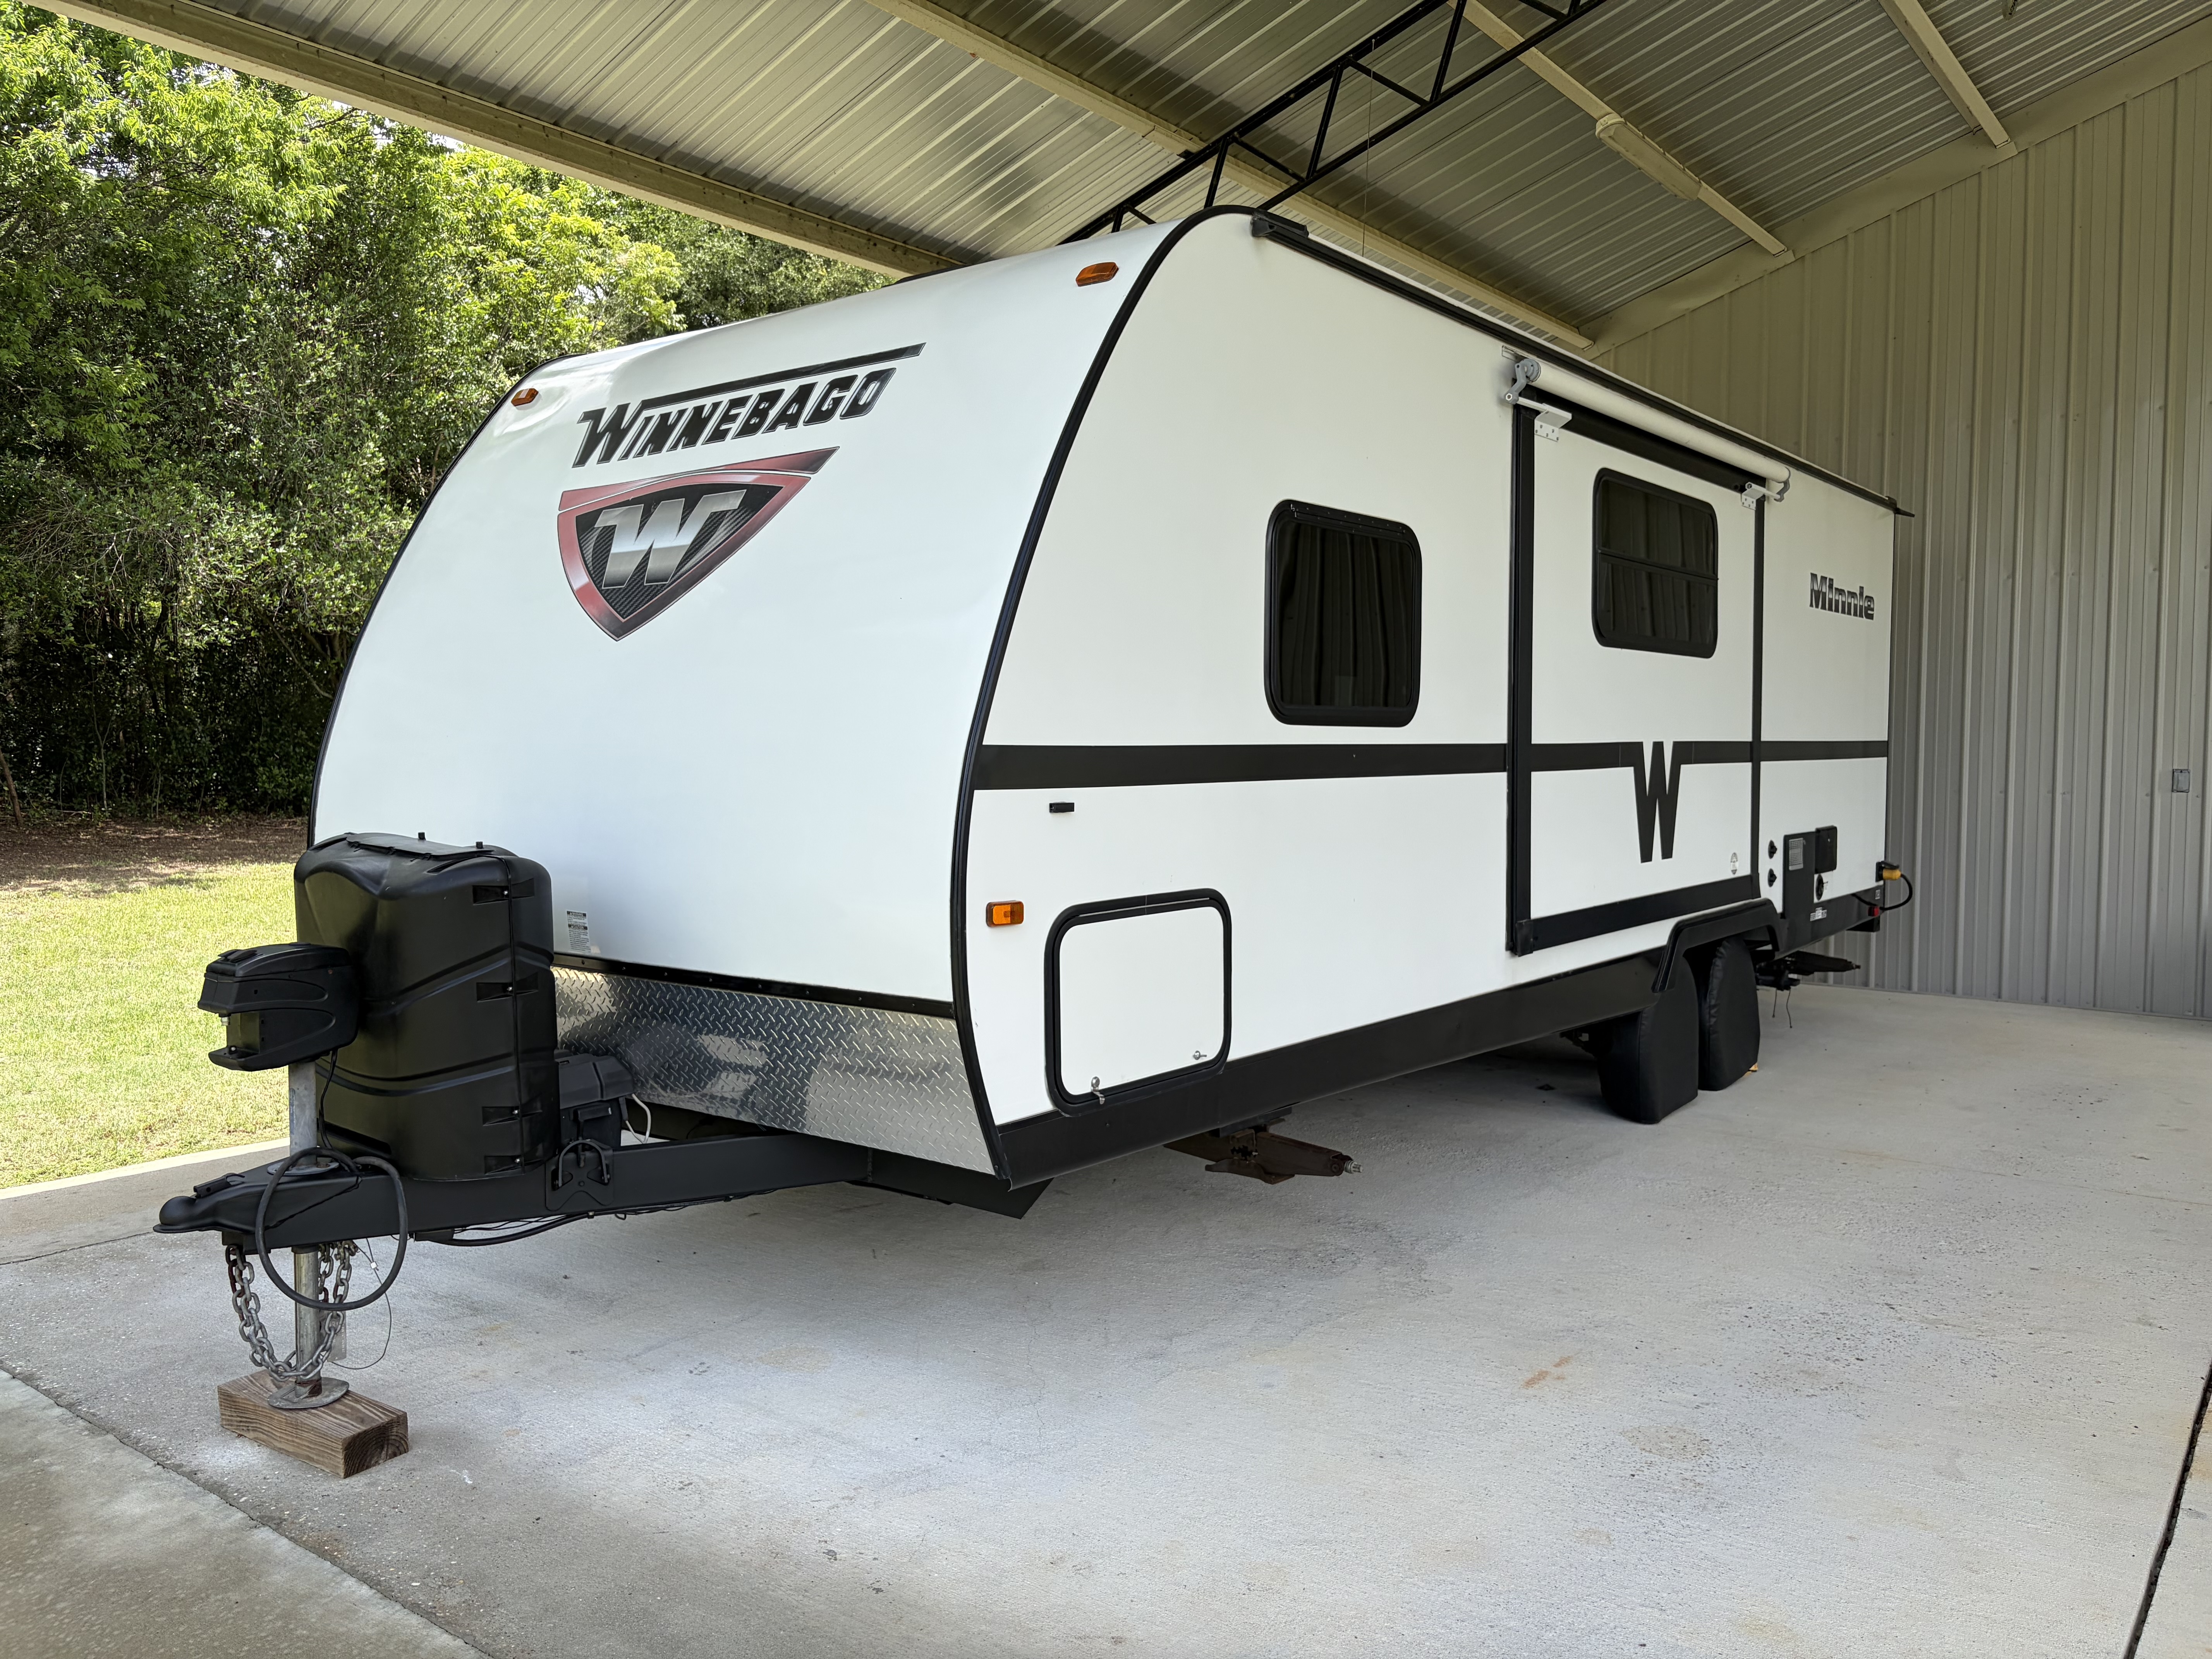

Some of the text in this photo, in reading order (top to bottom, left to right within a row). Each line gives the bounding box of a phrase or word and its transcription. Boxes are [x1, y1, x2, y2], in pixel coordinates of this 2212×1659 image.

[572, 368, 896, 468] WINNEBAGO
[594, 489, 746, 589] W
[1809, 572, 1874, 620] Minnie
